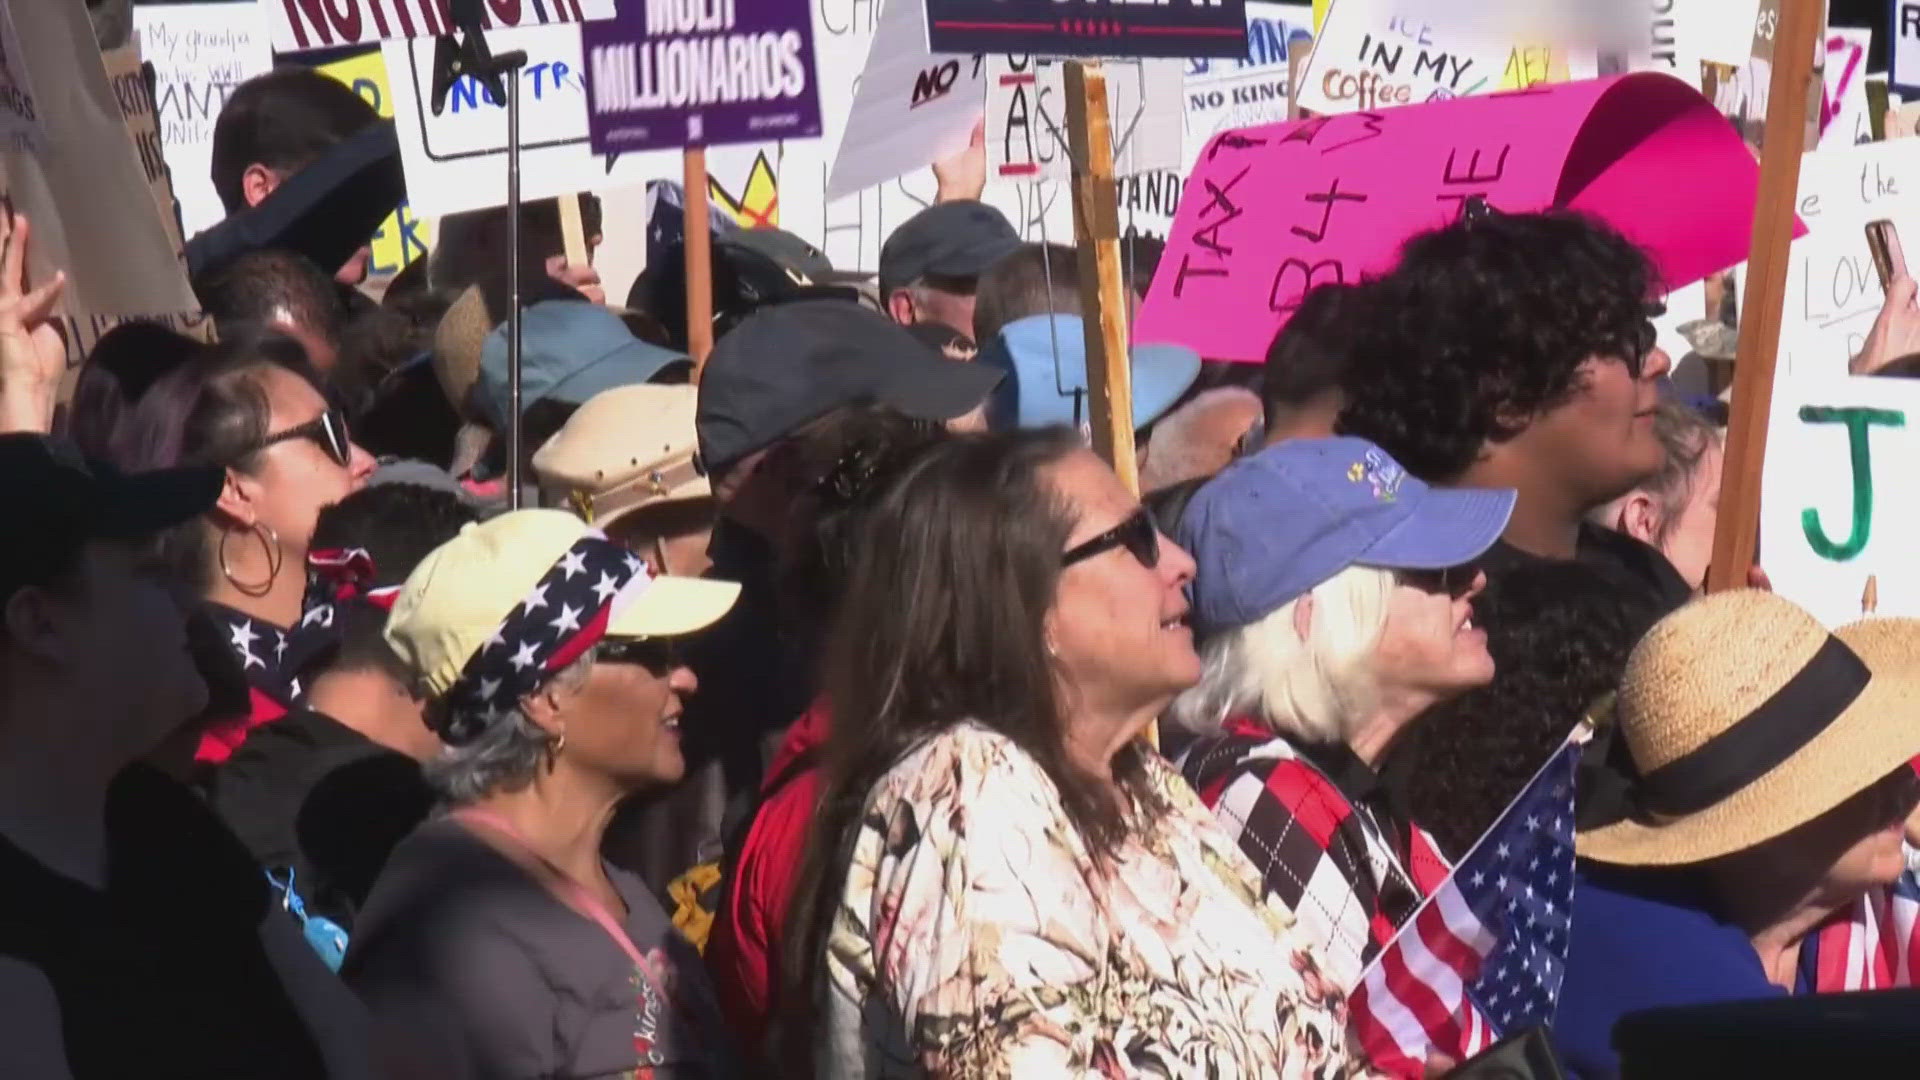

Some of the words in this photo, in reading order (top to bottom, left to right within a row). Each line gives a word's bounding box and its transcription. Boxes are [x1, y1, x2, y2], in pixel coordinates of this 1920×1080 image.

[591, 29, 806, 115] MILLIONARIOS
[911, 58, 960, 105] NO
[1322, 68, 1412, 112] Coffee
[1358, 34, 1403, 75] IN
[1413, 48, 1474, 89] MY
[1190, 90, 1225, 111] NO
[1173, 166, 1250, 299] TAX
[1804, 255, 1883, 322] LOV
[1799, 405, 1906, 562] J
